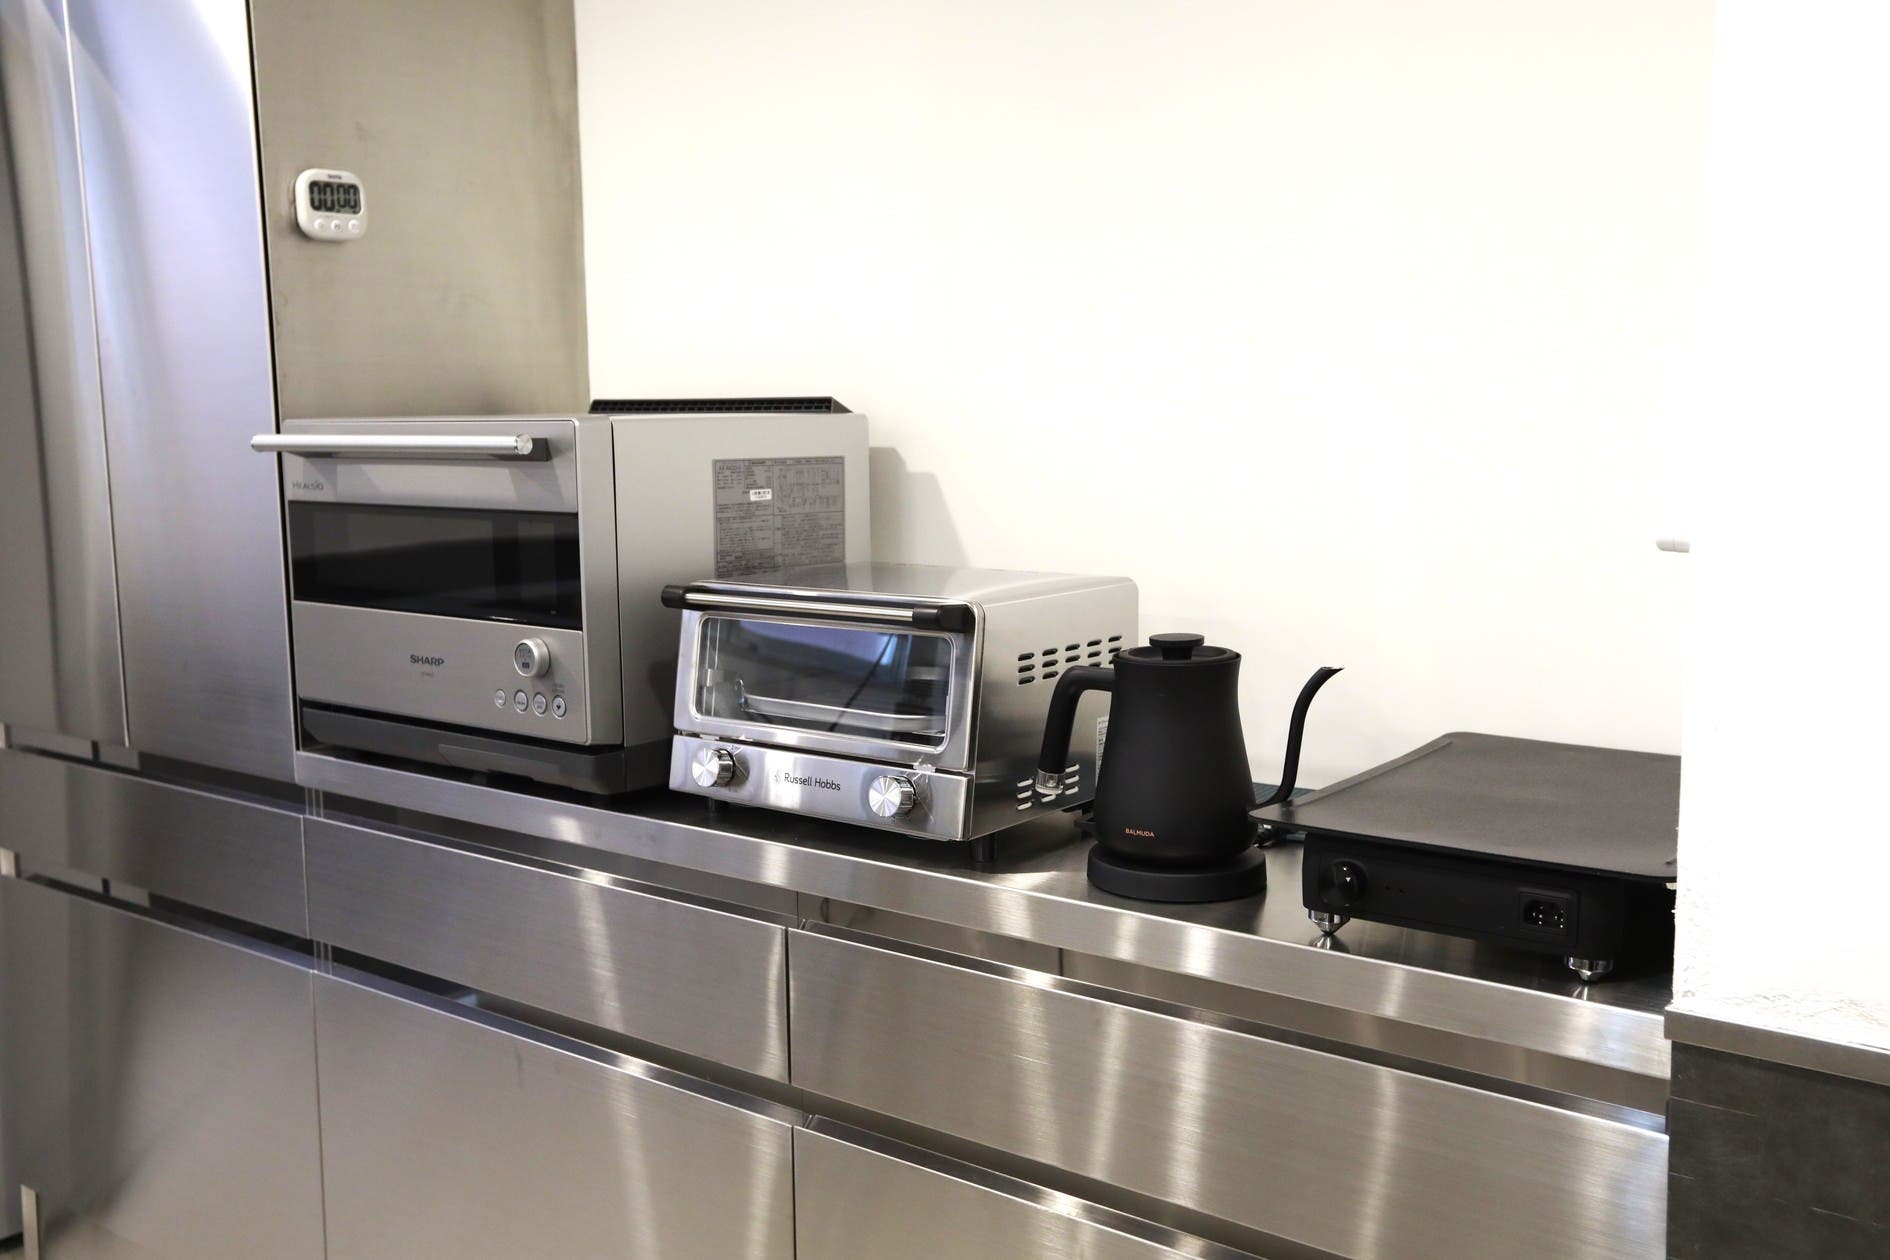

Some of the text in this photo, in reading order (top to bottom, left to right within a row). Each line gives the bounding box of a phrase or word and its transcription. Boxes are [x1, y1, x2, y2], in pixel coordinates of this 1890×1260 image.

[410, 654, 445, 666] SHARP
[784, 772, 841, 791] Russell Hobbs
